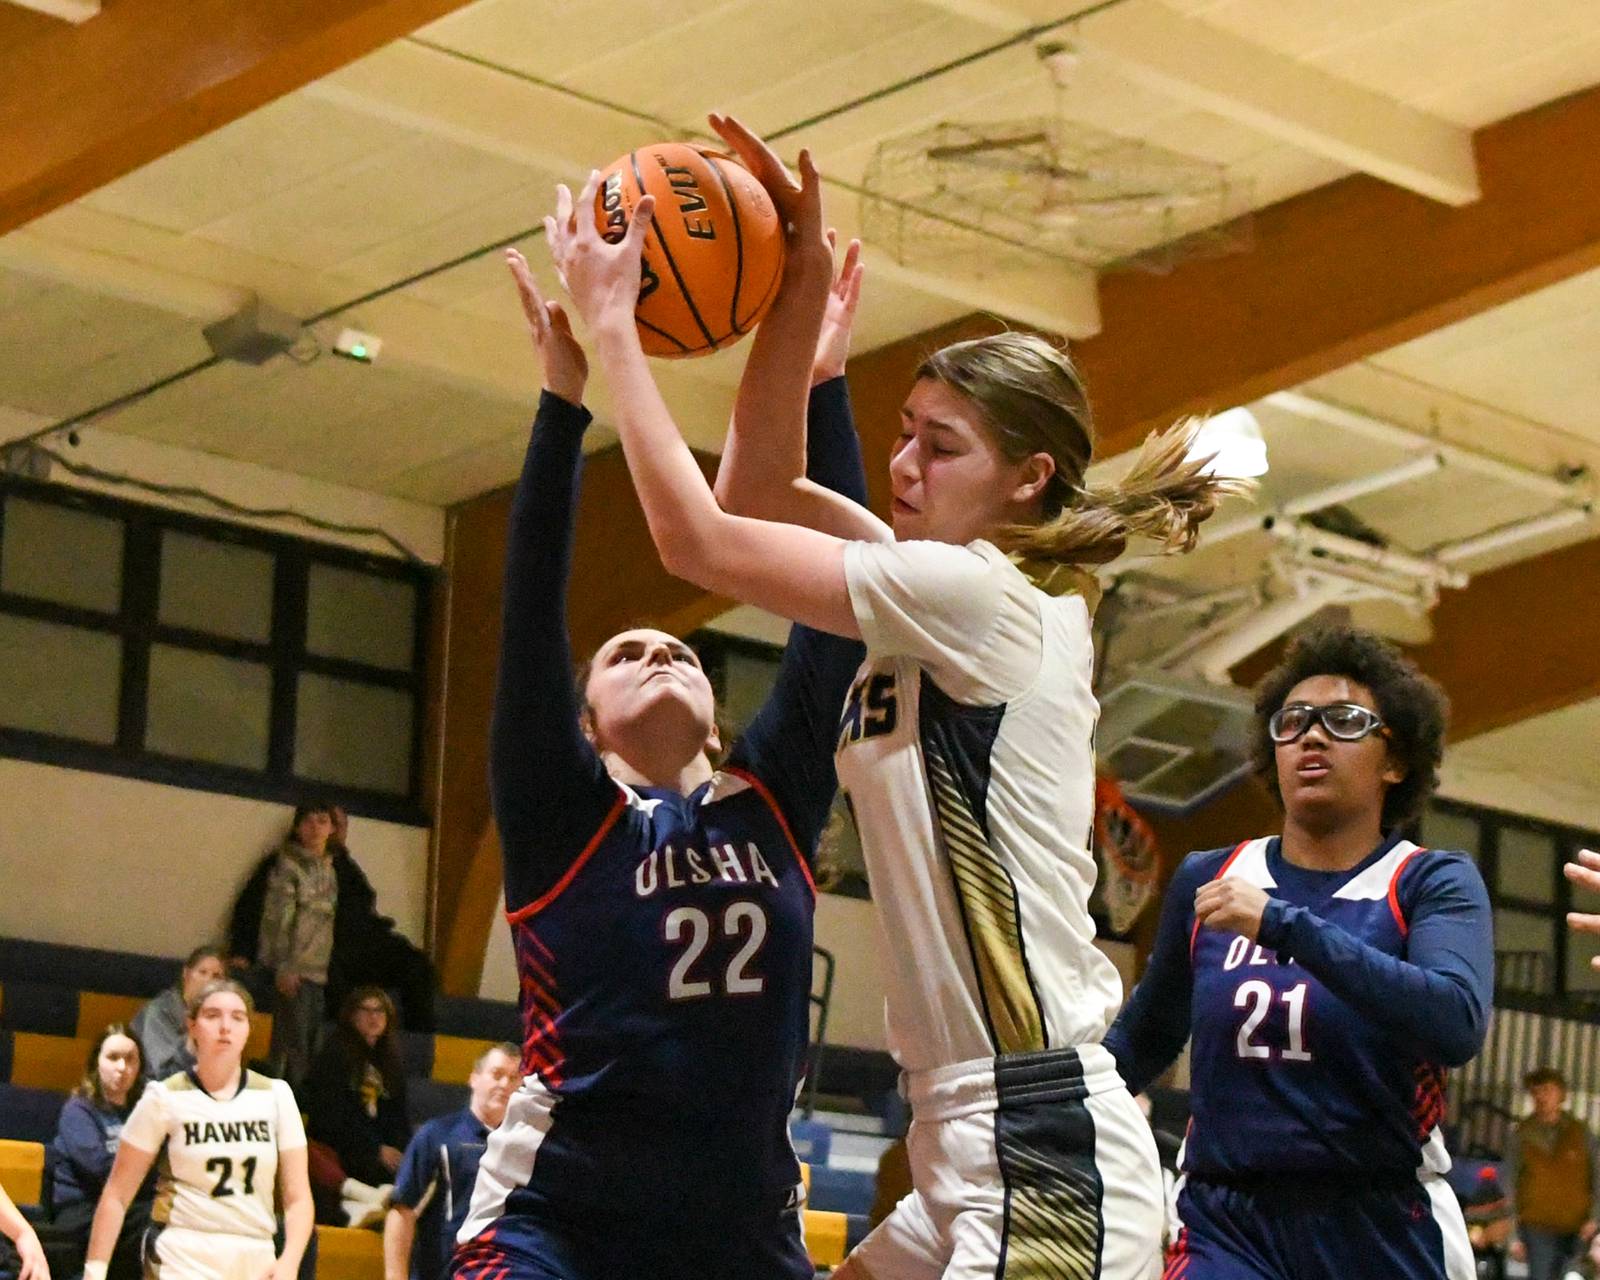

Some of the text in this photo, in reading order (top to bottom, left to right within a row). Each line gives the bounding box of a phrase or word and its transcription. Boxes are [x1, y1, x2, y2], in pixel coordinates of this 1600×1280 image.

[635, 842, 779, 896] OLSHA
[665, 902, 767, 999] 22
[1234, 980, 1312, 1061] 21
[183, 1120, 271, 1146] HAWKS
[206, 1156, 257, 1198] 21
